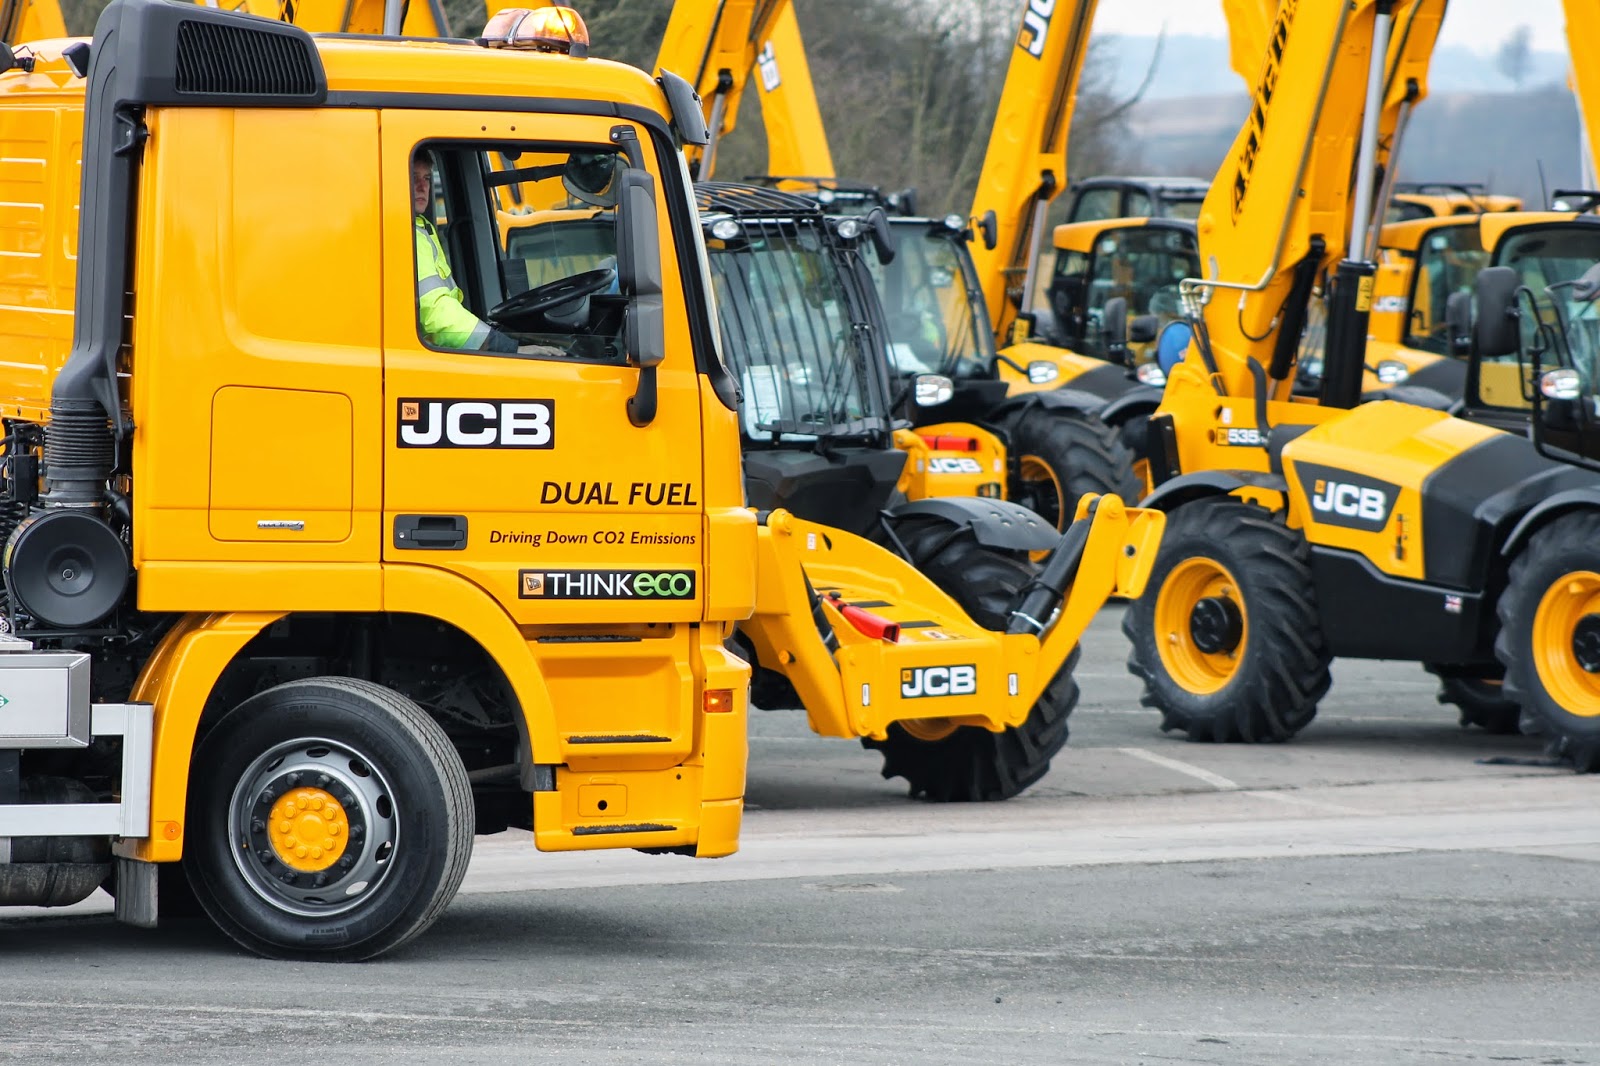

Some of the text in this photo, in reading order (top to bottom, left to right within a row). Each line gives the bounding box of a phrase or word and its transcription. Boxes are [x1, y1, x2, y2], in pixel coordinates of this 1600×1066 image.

[402, 402, 550, 445] JCB
[1228, 428, 1267, 444] 535
[928, 458, 983, 473] JCB
[540, 481, 697, 506] DUAL FUEL
[1313, 481, 1386, 520] JCB
[489, 530, 696, 547] Driving Down CO2 Emissions
[902, 665, 976, 697] JCB
